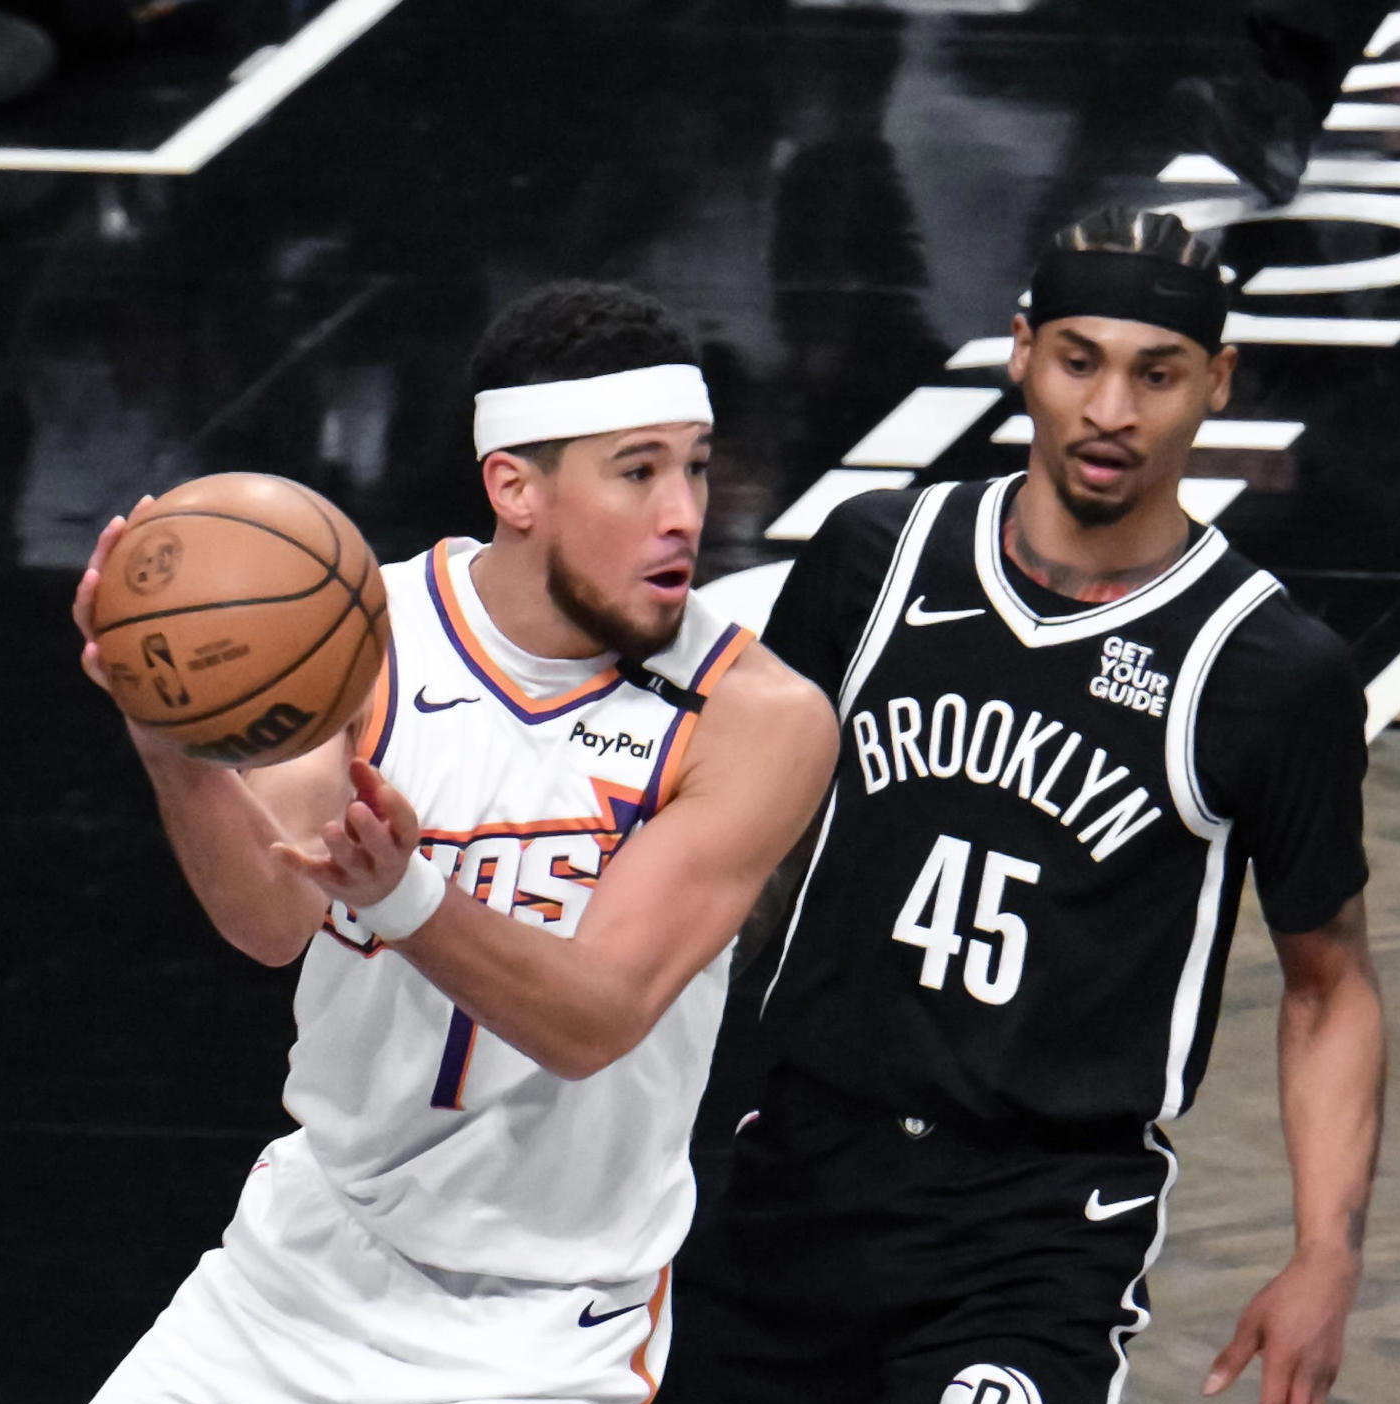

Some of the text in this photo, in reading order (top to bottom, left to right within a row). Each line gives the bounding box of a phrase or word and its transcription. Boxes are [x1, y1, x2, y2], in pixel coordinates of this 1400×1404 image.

[1103, 635, 1154, 669] GET
[1089, 675, 1167, 718] GUIDE
[1100, 655, 1169, 696] YOUR
[569, 721, 655, 760] PayPal
[853, 693, 1163, 863] BROOKLYN
[891, 834, 1042, 1006] 45
